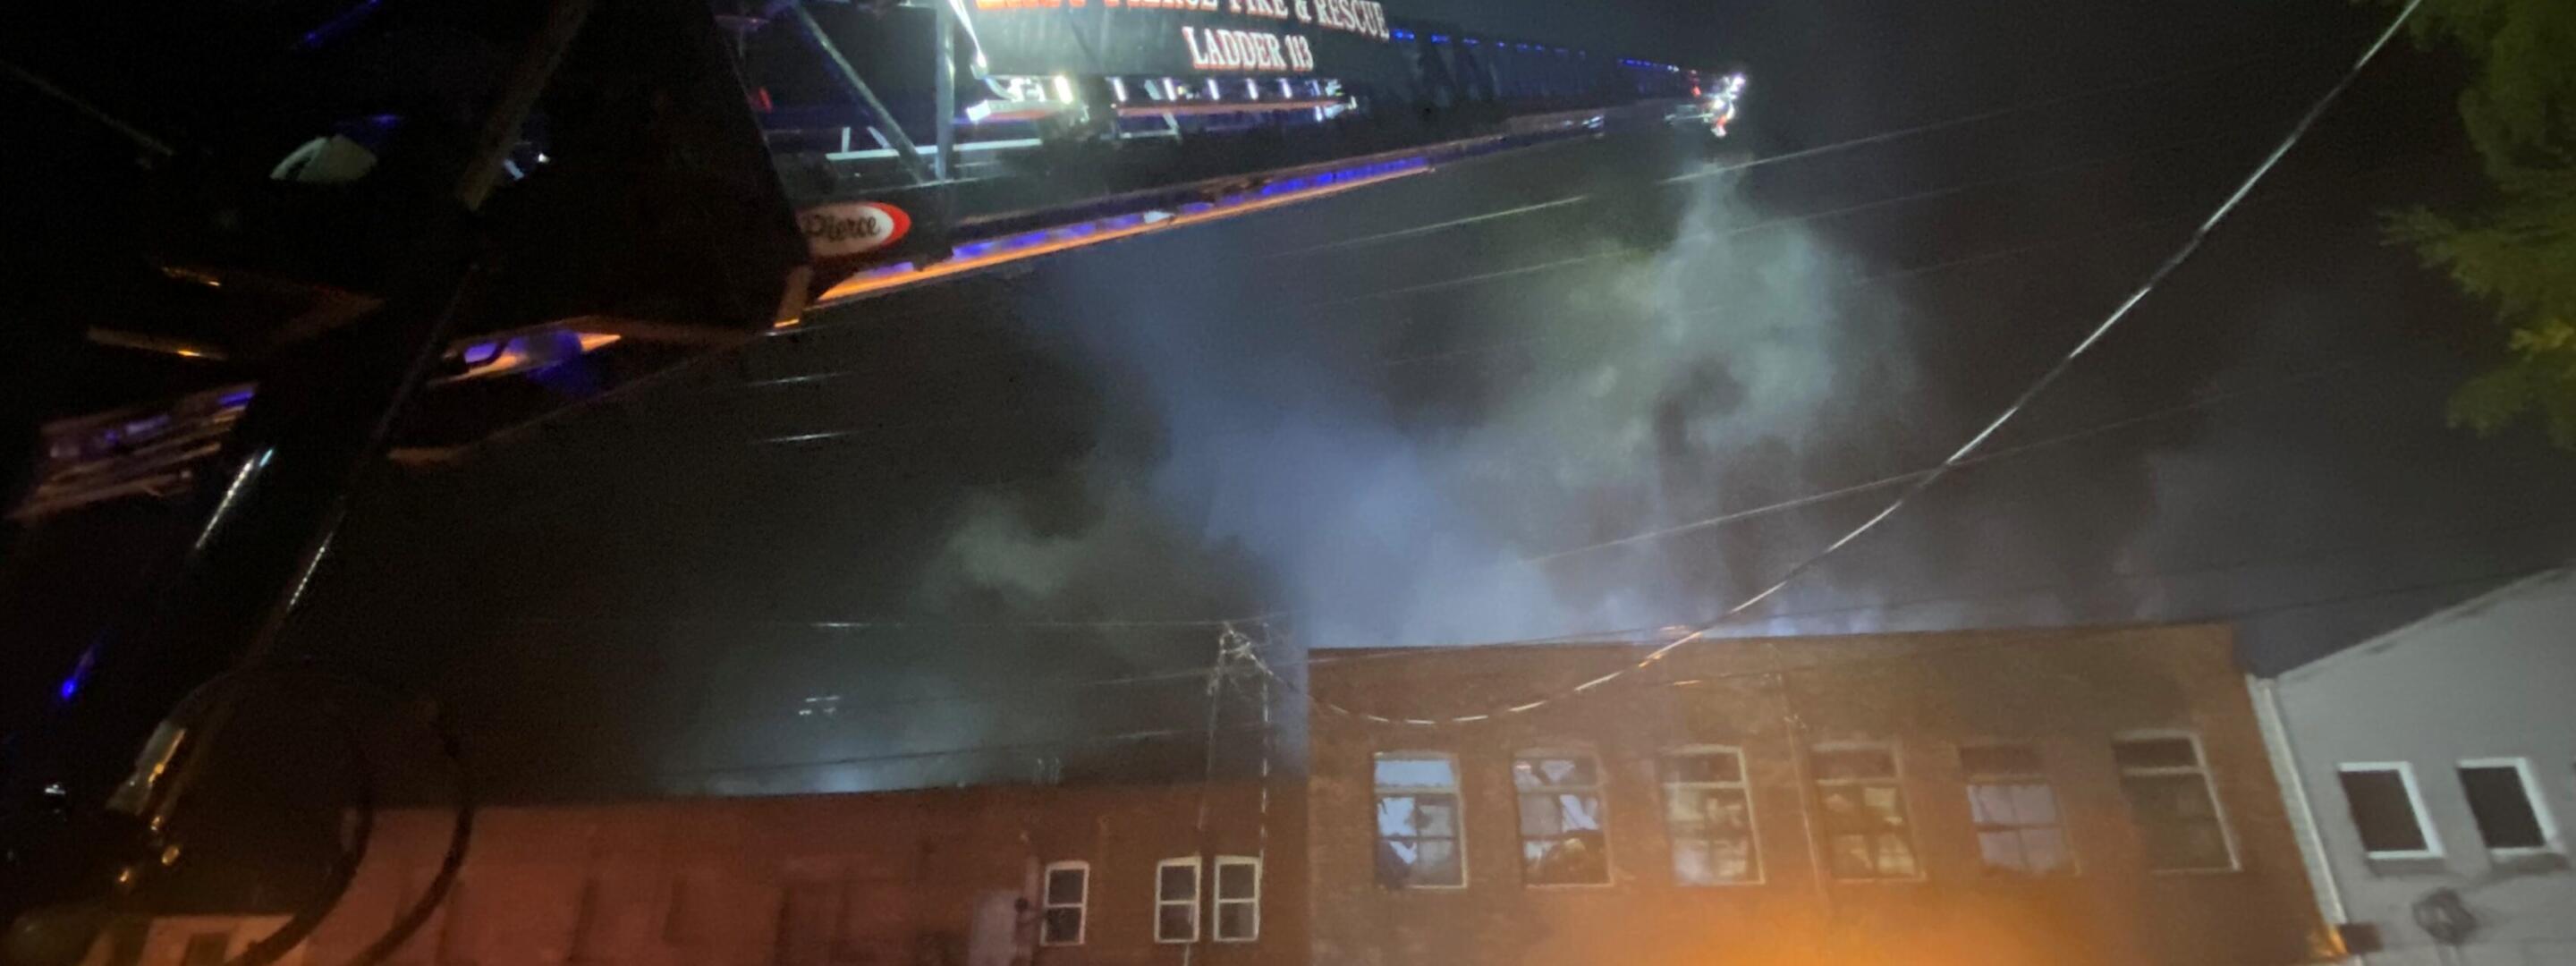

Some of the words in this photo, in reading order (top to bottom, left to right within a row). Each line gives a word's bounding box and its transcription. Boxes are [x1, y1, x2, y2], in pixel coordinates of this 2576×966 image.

[1294, 0, 1311, 22] &
[1312, 0, 1390, 39] RESCUE
[1182, 26, 1287, 70] LADDER
[1284, 34, 1314, 71] 113
[801, 215, 880, 242] Pierce
